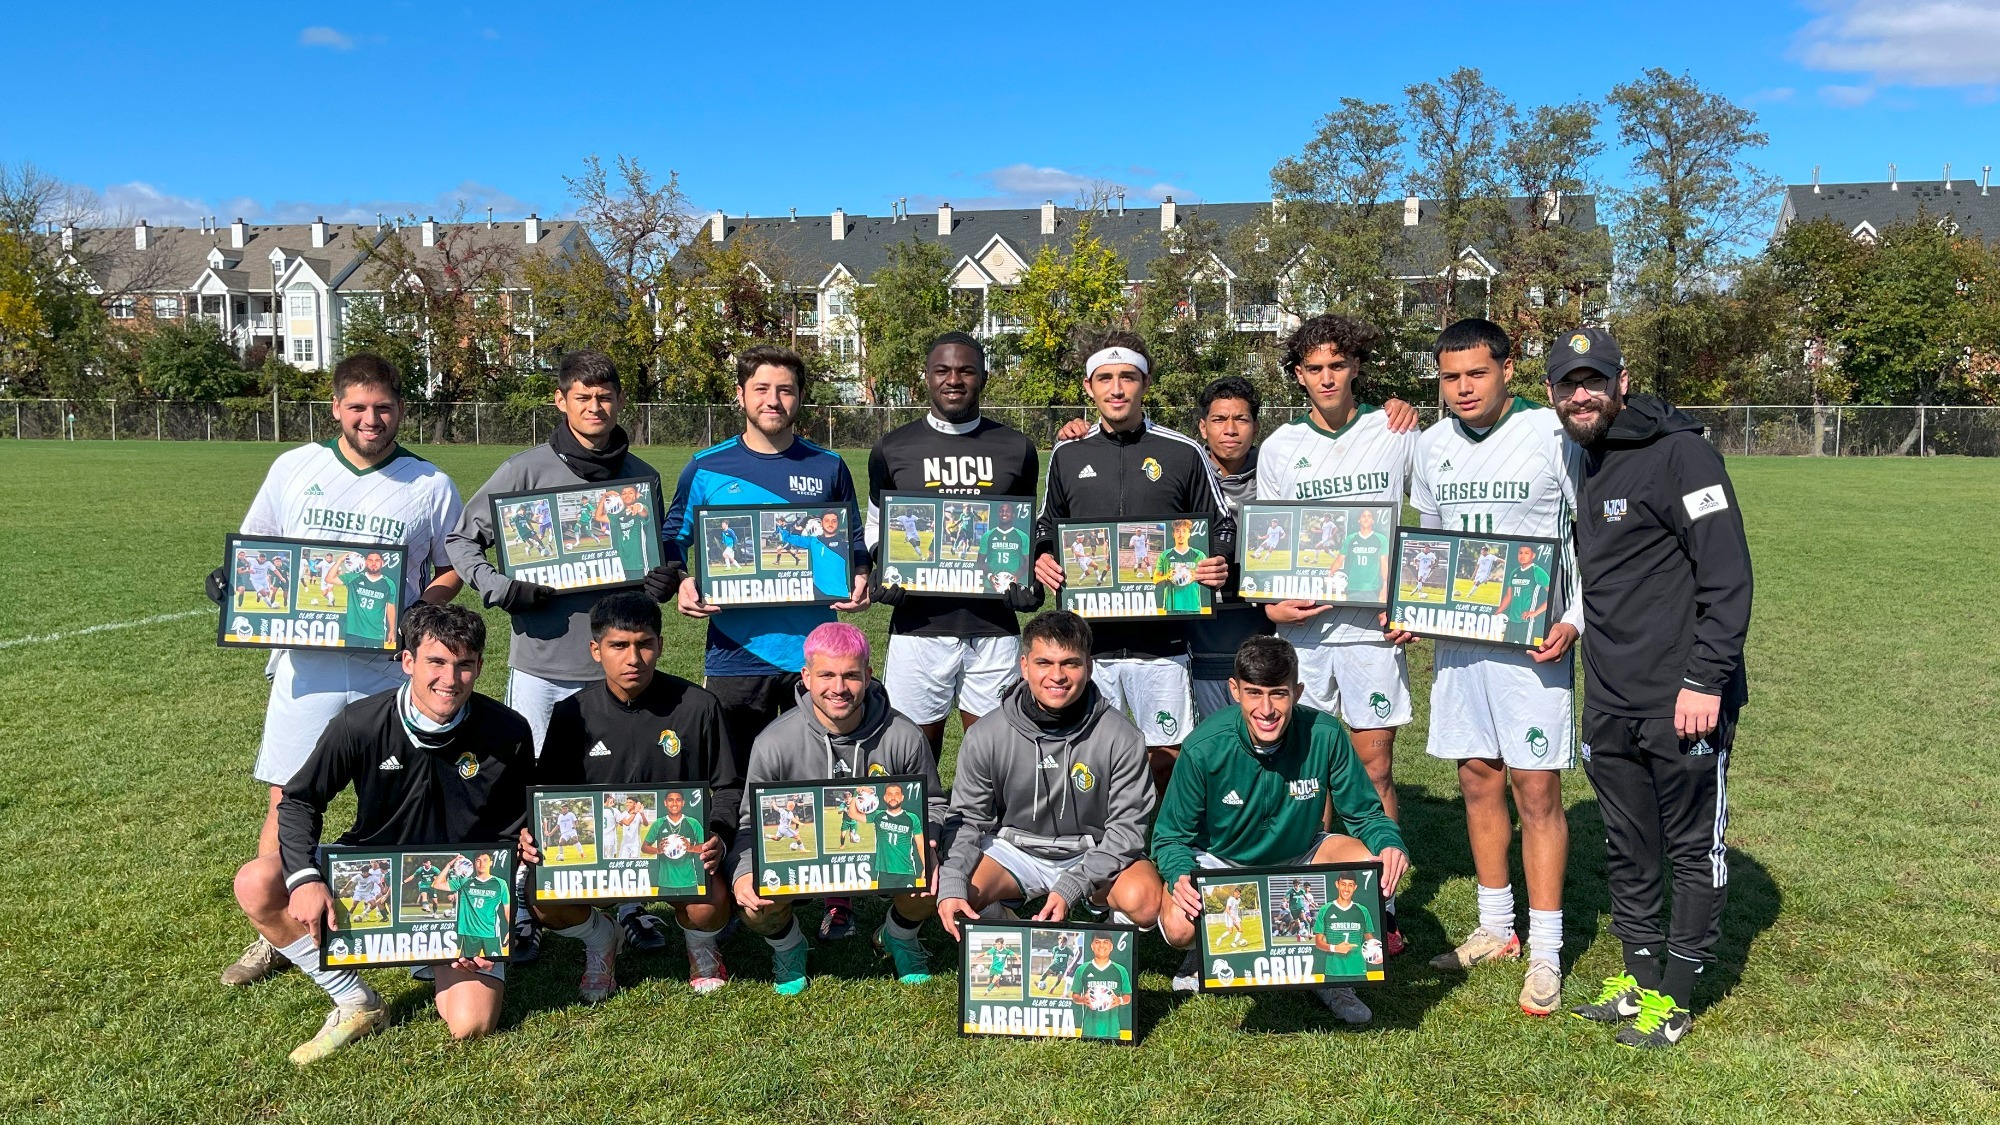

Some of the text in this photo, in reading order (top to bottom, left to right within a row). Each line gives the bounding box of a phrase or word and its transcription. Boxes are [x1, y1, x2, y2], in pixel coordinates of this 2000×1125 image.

[924, 456, 993, 486] NJCU
[789, 475, 823, 493] NJCU
[1295, 471, 1389, 500] JERSEY CITY
[1435, 481, 1530, 501] JERSEY CITY
[1016, 503, 1031, 519] 15
[1603, 498, 1627, 516] NJCU
[1698, 501, 1720, 512] adidas
[303, 508, 406, 539] JERSEY CITY
[381, 552, 400, 569] 33
[997, 552, 1010, 564] 15
[1357, 555, 1368, 566] 10
[1537, 544, 1552, 563] 14
[515, 557, 626, 590] ATEHORTUA
[916, 568, 984, 594] EVANDE
[712, 578, 815, 604] LINEBAUGH
[1272, 575, 1347, 601] DUARTE
[359, 597, 375, 610] 33
[1074, 591, 1158, 617] TARRIDA
[270, 618, 340, 646] RISCO
[1404, 605, 1505, 642] SALMERON
[906, 782, 921, 800] 11
[1289, 778, 1319, 796] NJCU
[689, 789, 702, 807] 3
[887, 832, 898, 845] 11
[492, 850, 509, 869] 19
[553, 868, 652, 899] URTEAGA
[798, 862, 872, 893] FALLAS
[1361, 870, 1373, 891] 7
[472, 897, 485, 908] 19
[364, 930, 458, 962] VARGAS
[1117, 931, 1129, 952] 6
[1342, 932, 1350, 943] 7
[1254, 954, 1316, 985] CRUZ
[979, 1004, 1076, 1037] ARGUETA
